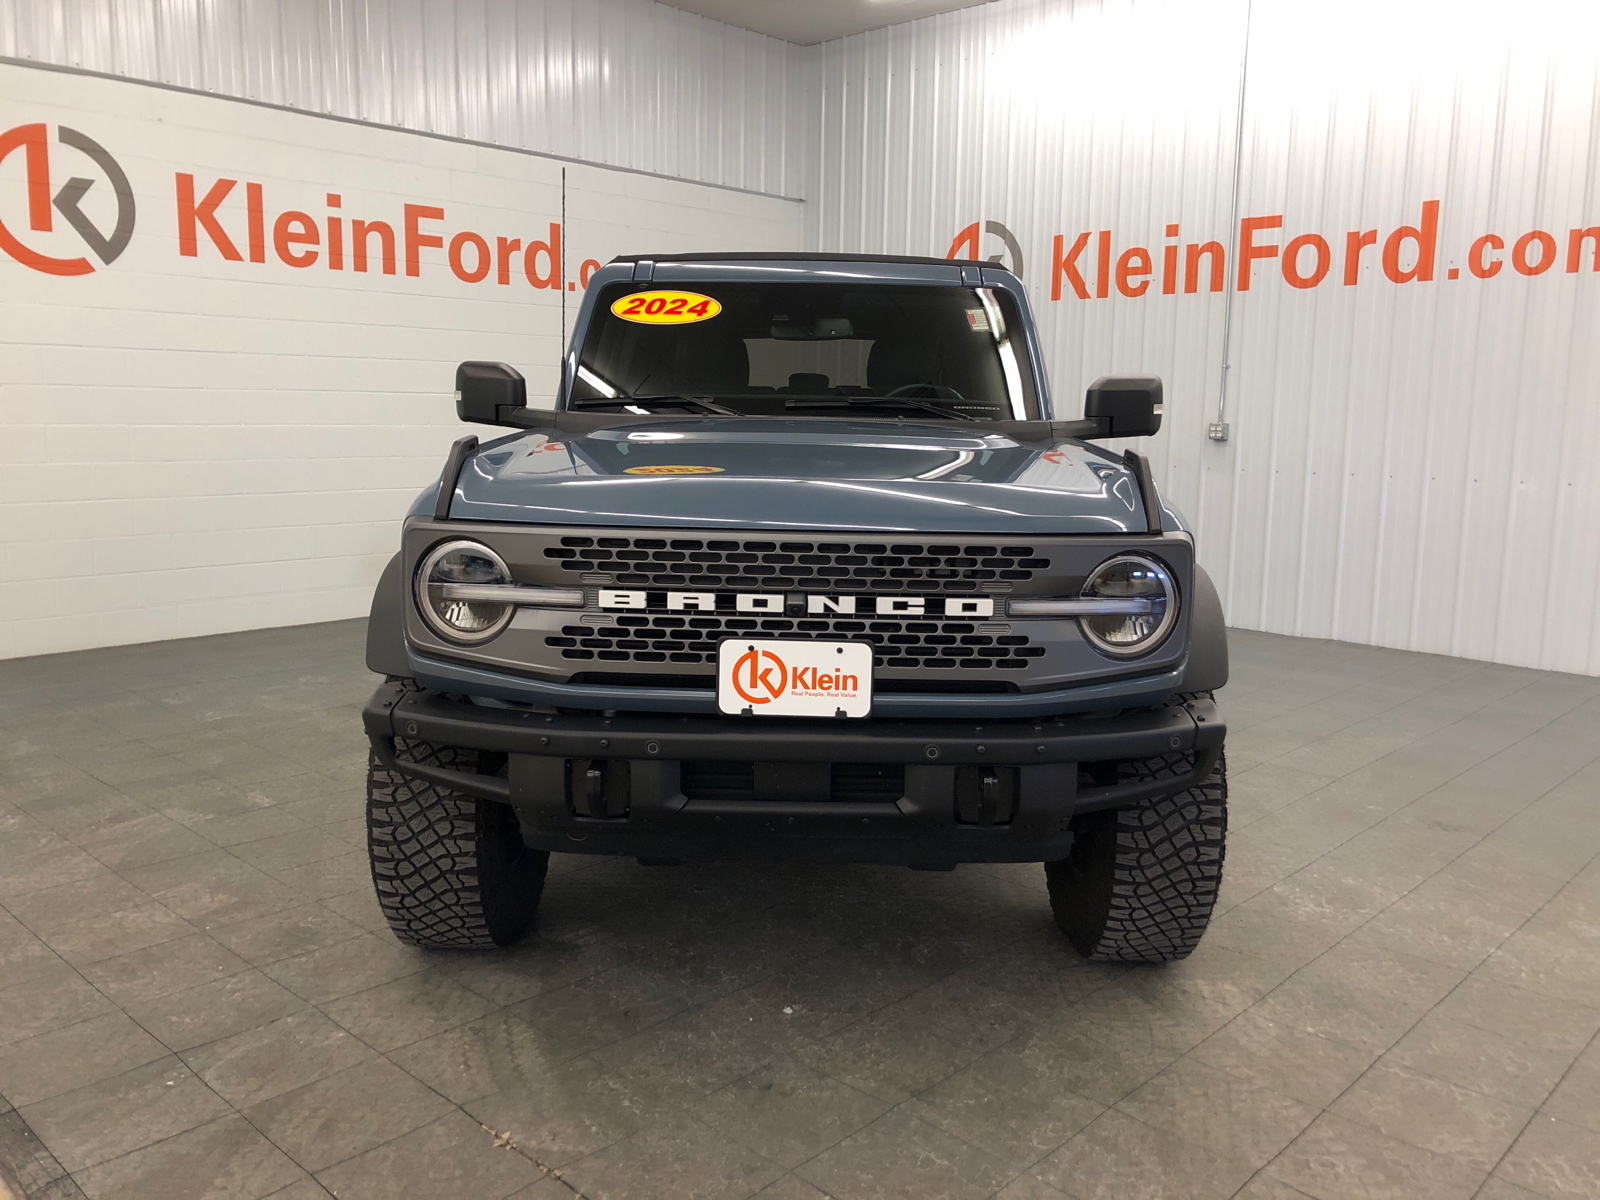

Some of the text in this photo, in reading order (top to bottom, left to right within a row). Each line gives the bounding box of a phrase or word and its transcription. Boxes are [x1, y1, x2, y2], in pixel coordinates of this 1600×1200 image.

[620, 297, 711, 317] 2024
[598, 588, 994, 617] BRONCO
[791, 666, 858, 692] Klein
